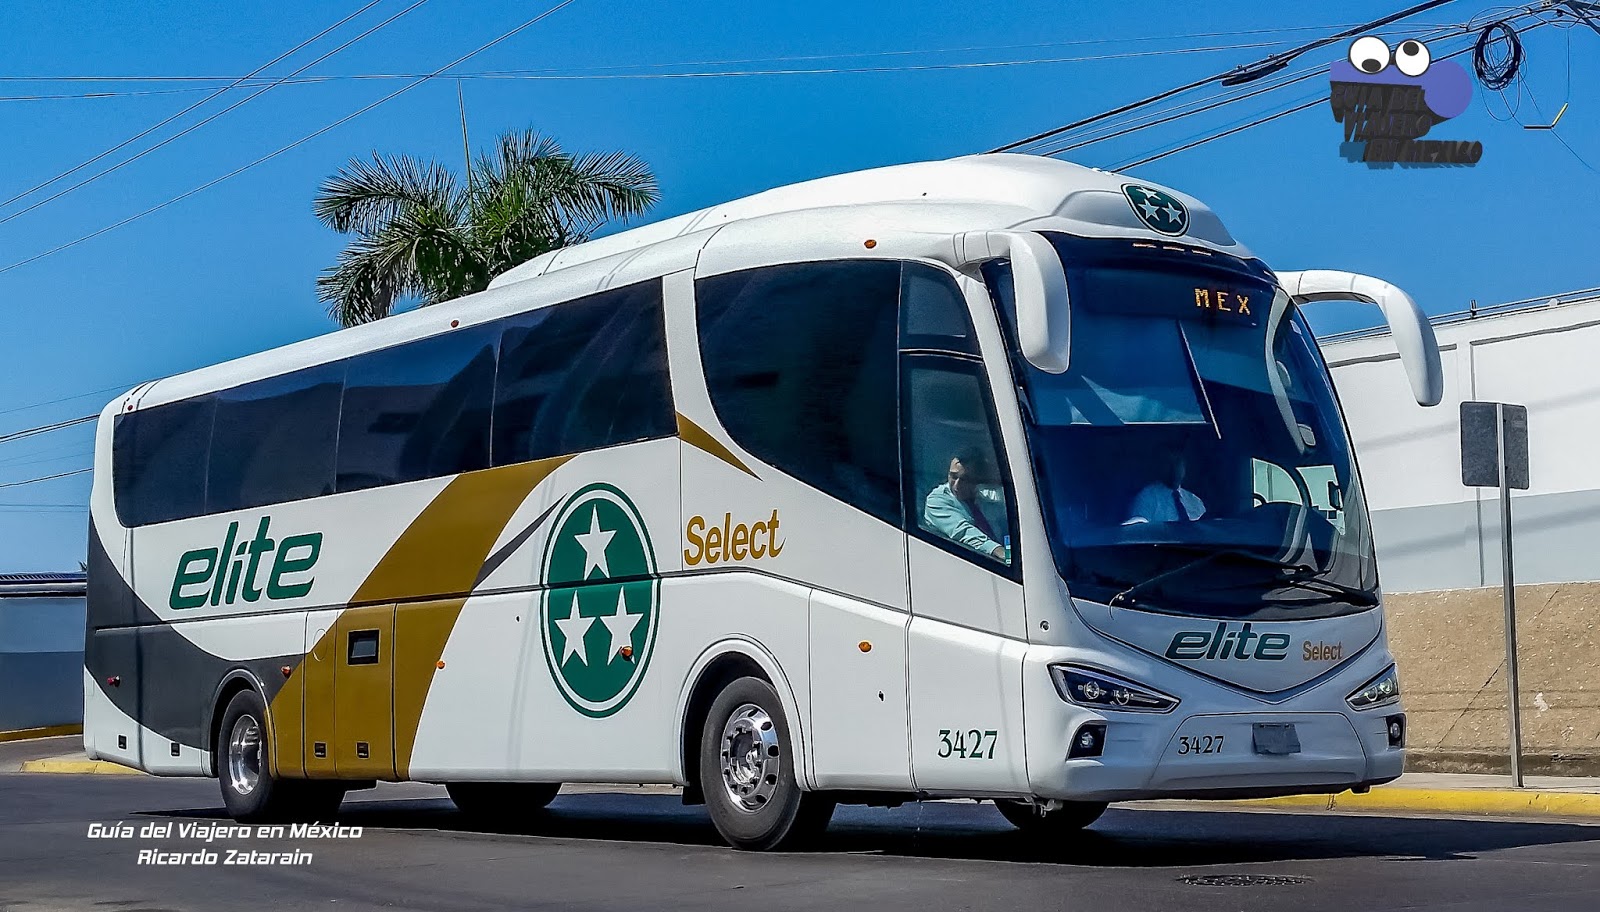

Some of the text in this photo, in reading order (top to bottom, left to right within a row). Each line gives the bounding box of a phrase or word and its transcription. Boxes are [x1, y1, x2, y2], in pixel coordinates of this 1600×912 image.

[1194, 288, 1251, 316] MEX
[684, 509, 786, 566] Select
[169, 516, 323, 610] elite
[1165, 622, 1343, 661] elite Select
[937, 729, 998, 760] 3427
[1177, 735, 1224, 755] 3427
